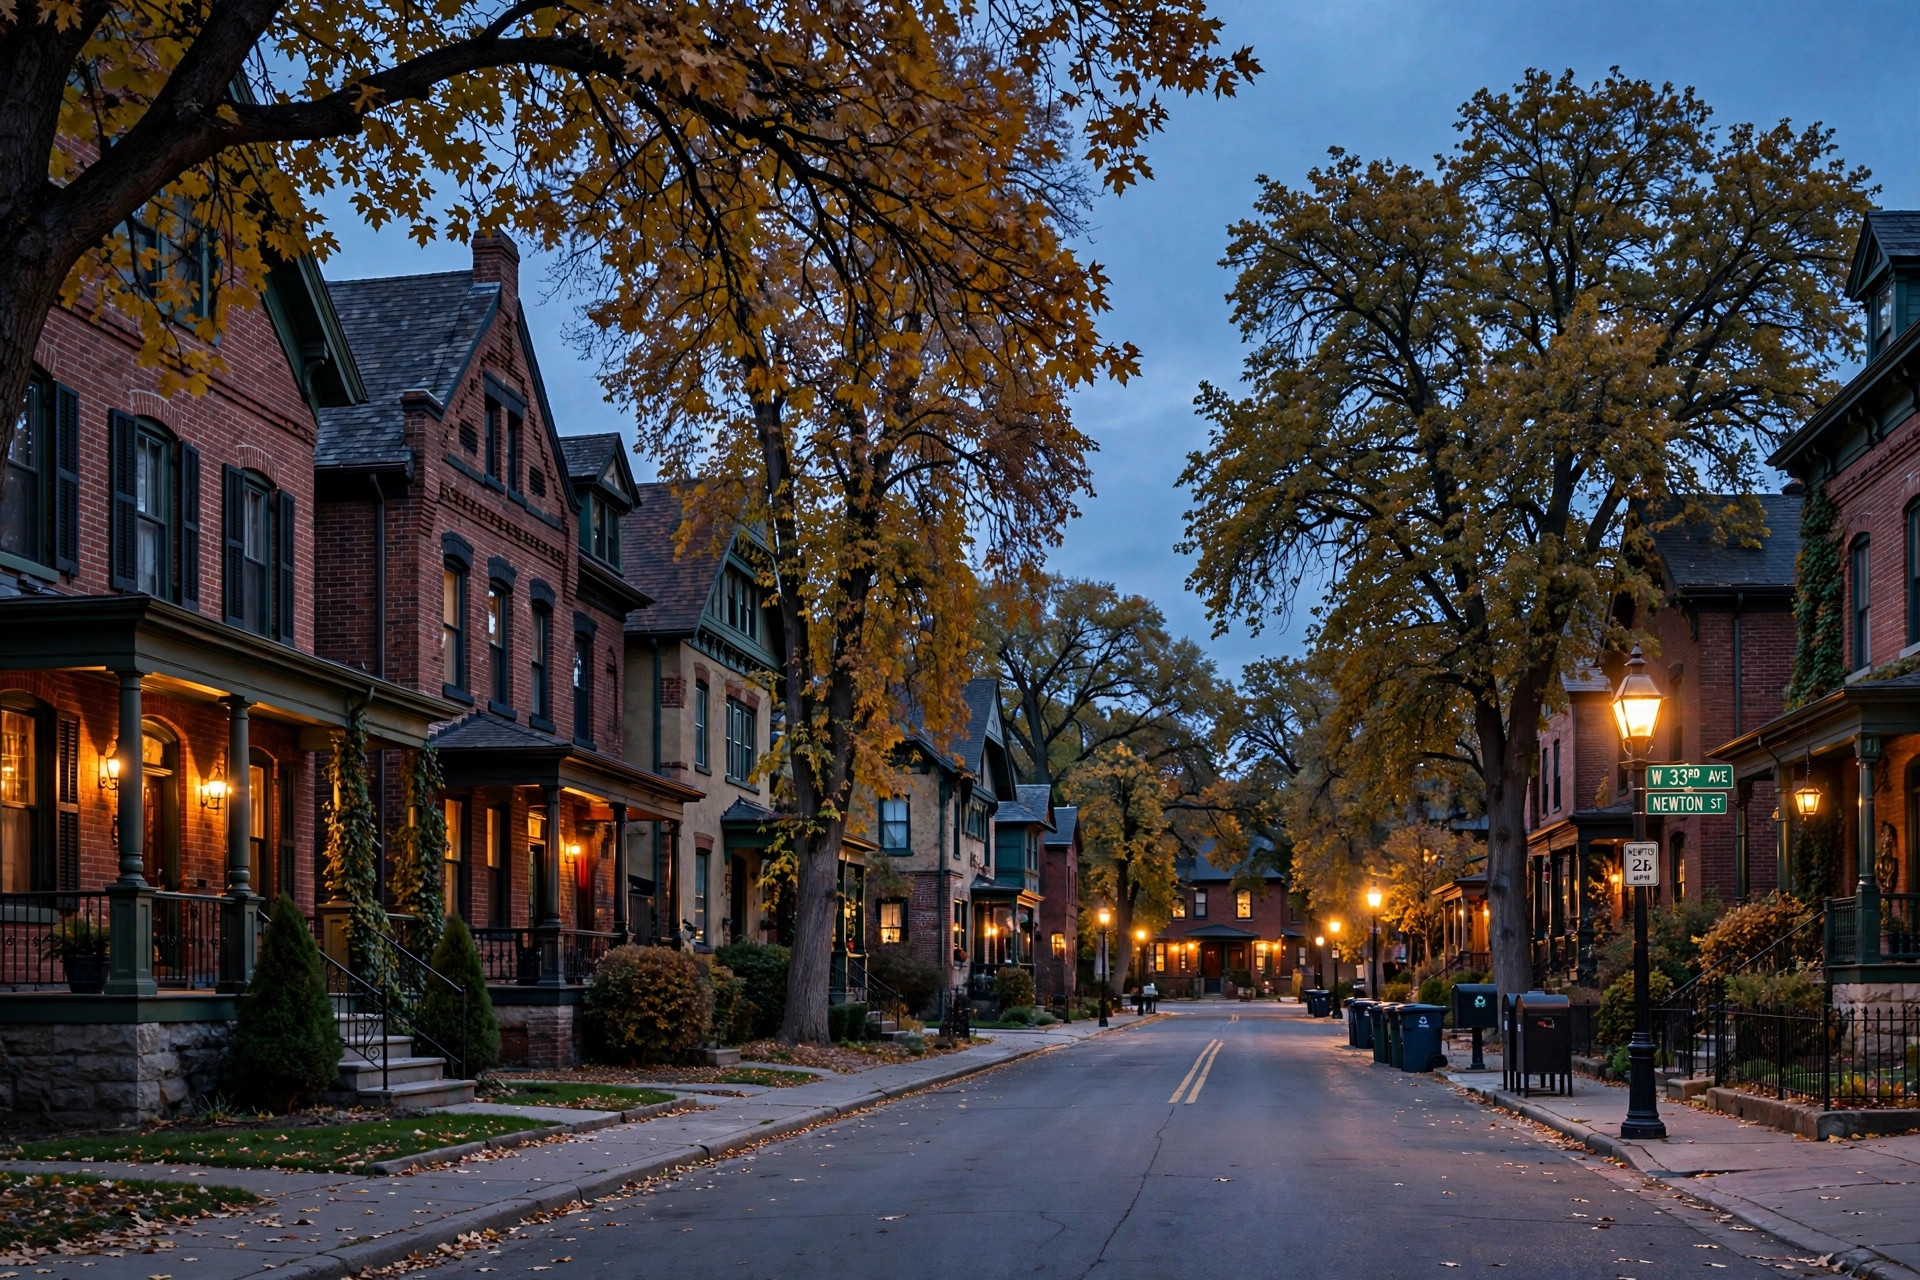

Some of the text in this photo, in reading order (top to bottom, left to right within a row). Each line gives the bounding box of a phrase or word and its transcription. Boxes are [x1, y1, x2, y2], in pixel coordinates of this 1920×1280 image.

[1652, 768, 1728, 785] W 33RD AVE
[1653, 796, 1722, 811] NEWTON ST
